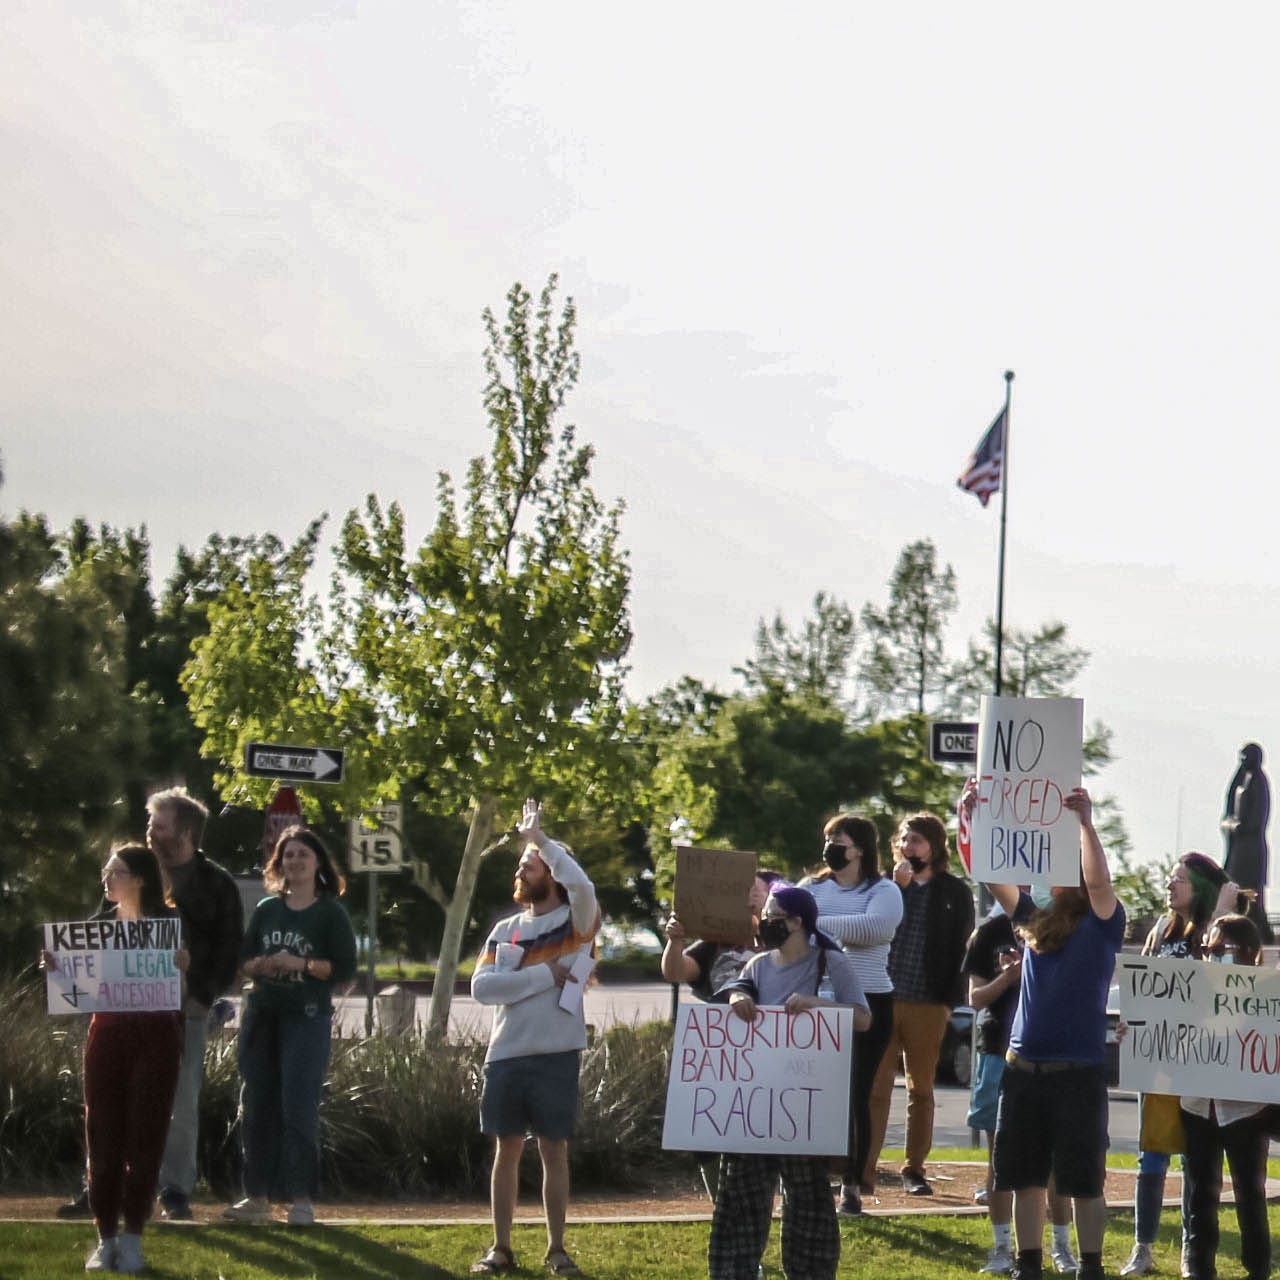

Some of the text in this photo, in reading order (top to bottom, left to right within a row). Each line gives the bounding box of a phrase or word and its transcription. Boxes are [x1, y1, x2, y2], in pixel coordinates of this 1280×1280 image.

[944, 735, 974, 751] ONE
[992, 719, 1044, 773] NO
[256, 753, 283, 769] ONE
[976, 775, 1063, 826] FORCED
[359, 840, 392, 866] 15
[991, 826, 1052, 874] BIRTH
[52, 921, 114, 951] KEEP
[124, 952, 178, 978] LEGAL
[1225, 974, 1256, 992] MY
[682, 1007, 841, 1053] ABORTION
[681, 1048, 754, 1083] BANS
[691, 1086, 825, 1143] RACIST
